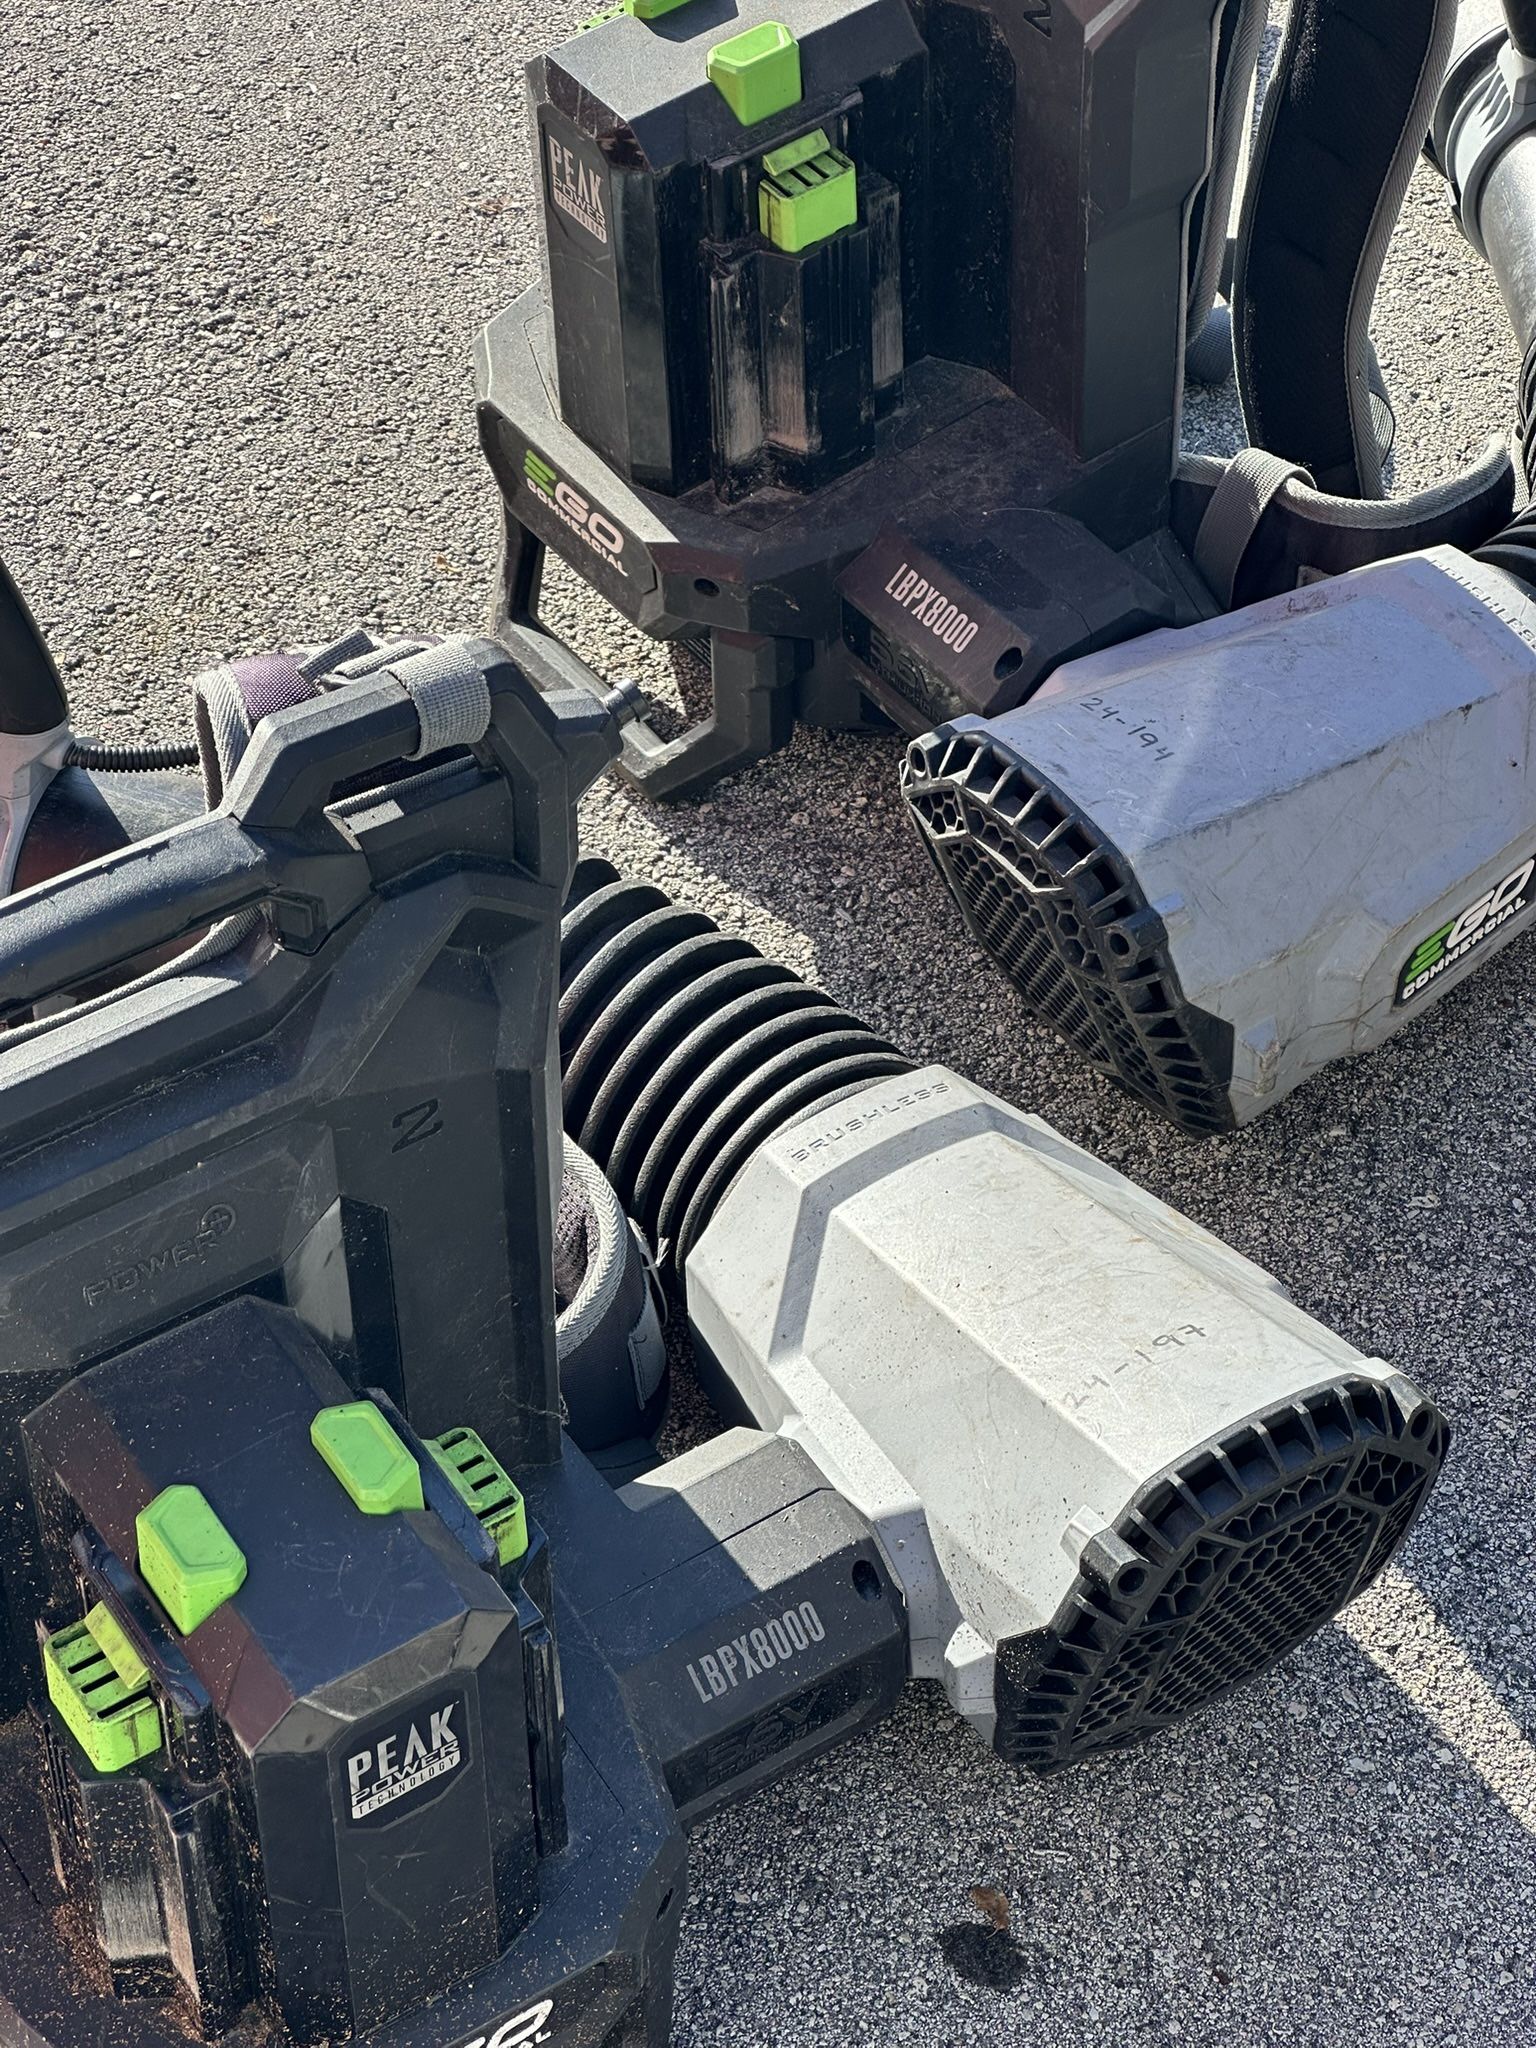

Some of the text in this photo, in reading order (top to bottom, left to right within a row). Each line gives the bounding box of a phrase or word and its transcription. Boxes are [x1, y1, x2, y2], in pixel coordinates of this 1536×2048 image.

[549, 135, 604, 217] PEAK
[552, 175, 606, 229] POWER
[523, 449, 624, 554] EGO
[526, 477, 629, 577] COMMERCIAL
[884, 563, 979, 654] LBPX8000
[1080, 697, 1175, 762] 24-194
[1402, 897, 1526, 1000] COMMERCIAL
[1405, 859, 1535, 983] EGO
[787, 1082, 950, 1162] BRUSHLESS
[1063, 1324, 1206, 1409] 24-197
[686, 1601, 826, 1704] LBPX8000
[347, 1704, 457, 1794] PEAK
[352, 1739, 460, 1806] POWER
[356, 1754, 457, 1815] TECHNOLOGY
